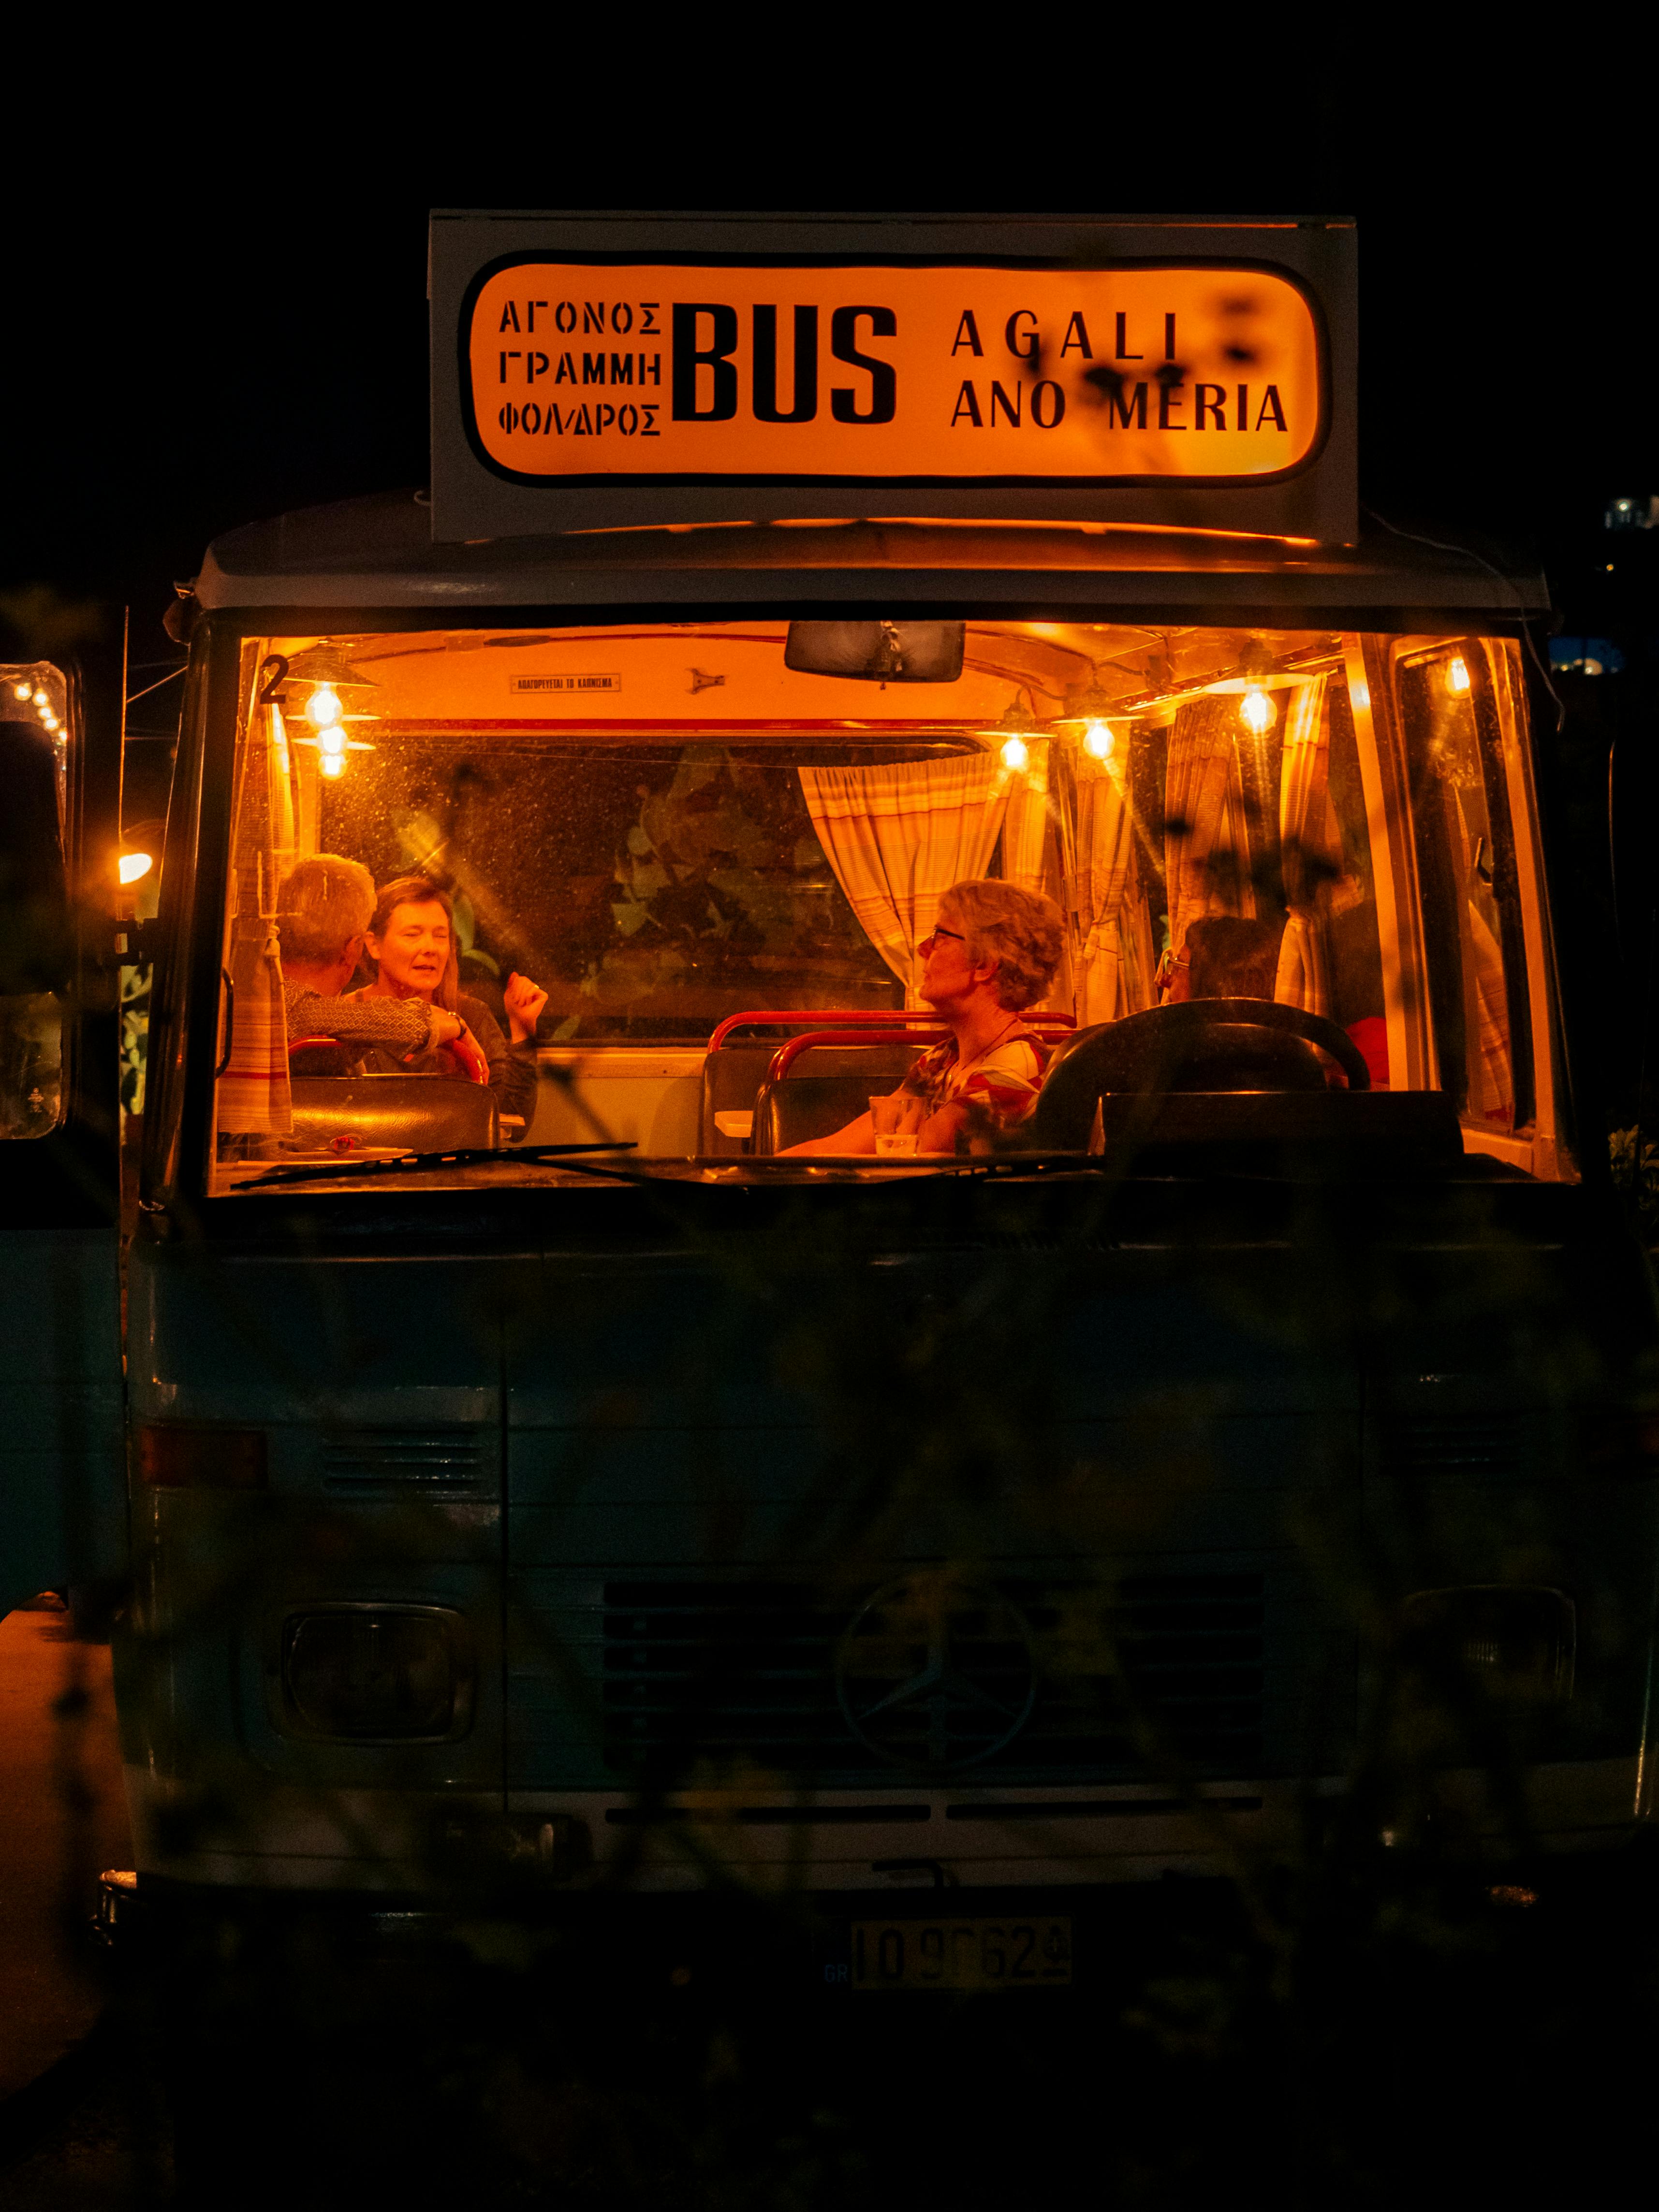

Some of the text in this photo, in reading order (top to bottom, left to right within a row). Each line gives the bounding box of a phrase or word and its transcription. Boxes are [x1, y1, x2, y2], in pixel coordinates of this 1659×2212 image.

[499, 300, 661, 335] ΑΓΟΝΟΣ
[951, 309, 1176, 360] AGALI
[499, 351, 661, 385] ΓΡΑΜΜΗ
[672, 302, 897, 424] BUS
[951, 380, 1288, 432] ANO MERIA
[260, 654, 289, 704] 2
[823, 1963, 849, 1983] GR
